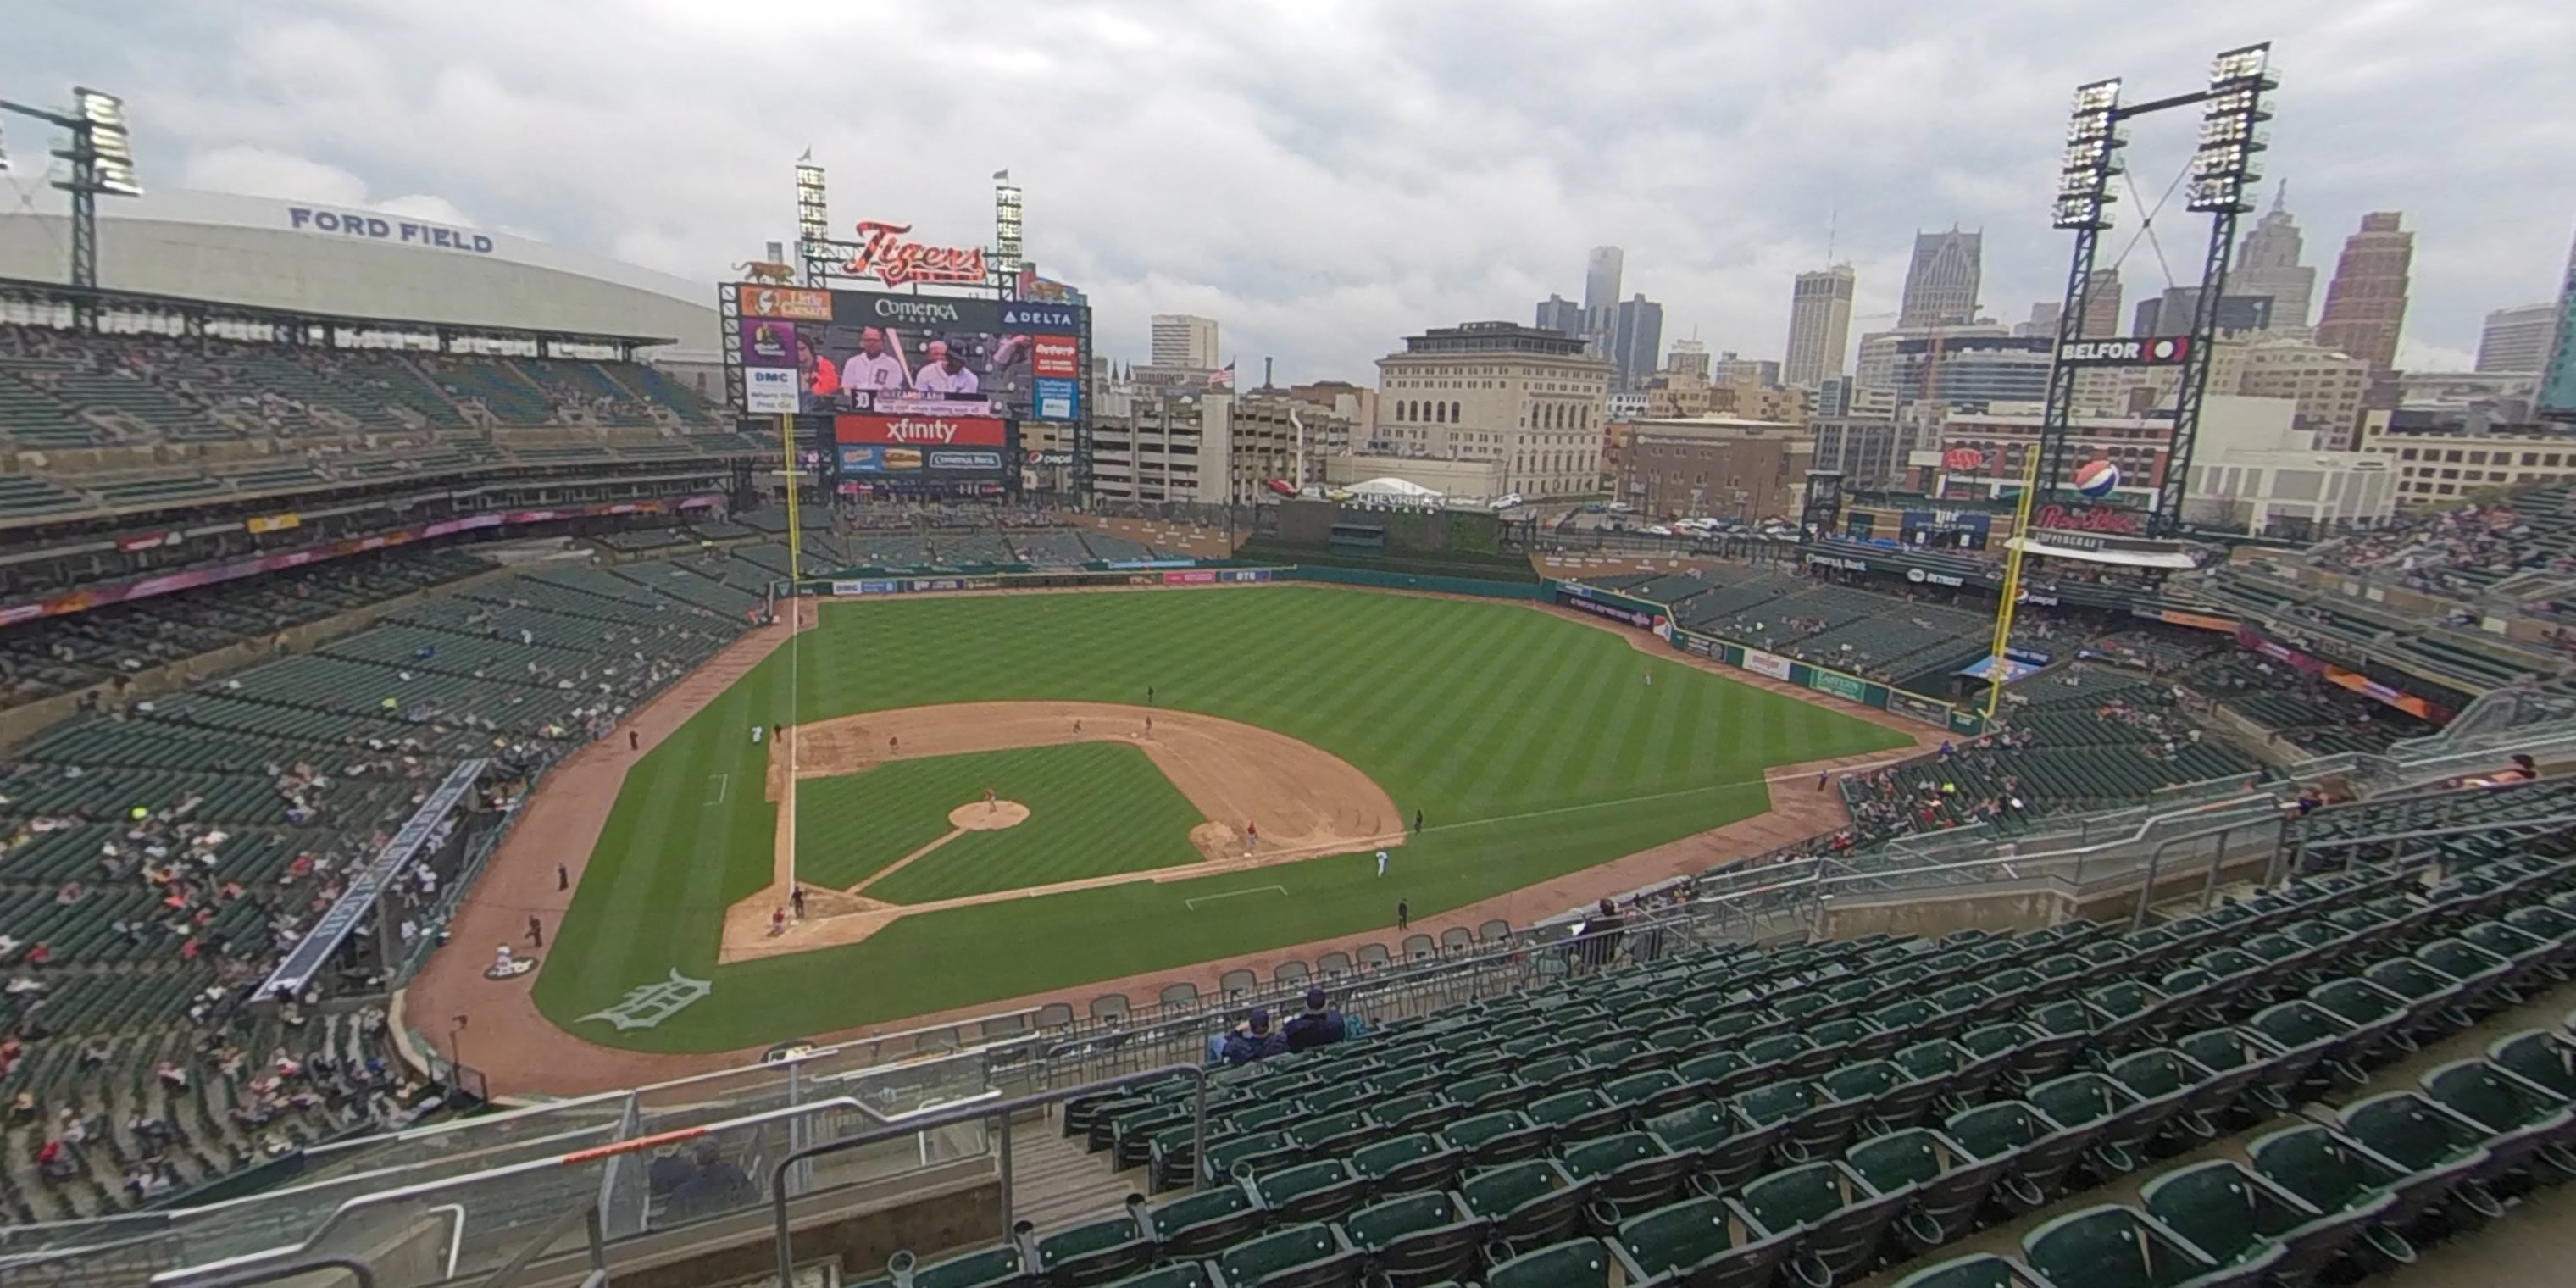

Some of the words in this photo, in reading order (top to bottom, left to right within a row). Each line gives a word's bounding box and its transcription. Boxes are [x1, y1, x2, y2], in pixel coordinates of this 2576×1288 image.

[288, 208, 390, 238] FORD
[400, 222, 494, 253] FIELD
[841, 221, 988, 289] Tigers
[1020, 311, 1072, 325] DELTA
[2061, 341, 2140, 360] BELFOR
[755, 371, 788, 383] DMC
[886, 418, 958, 443] xfinity
[1044, 454, 1073, 465] pepsi
[1358, 493, 1446, 508] CHEVROLET
